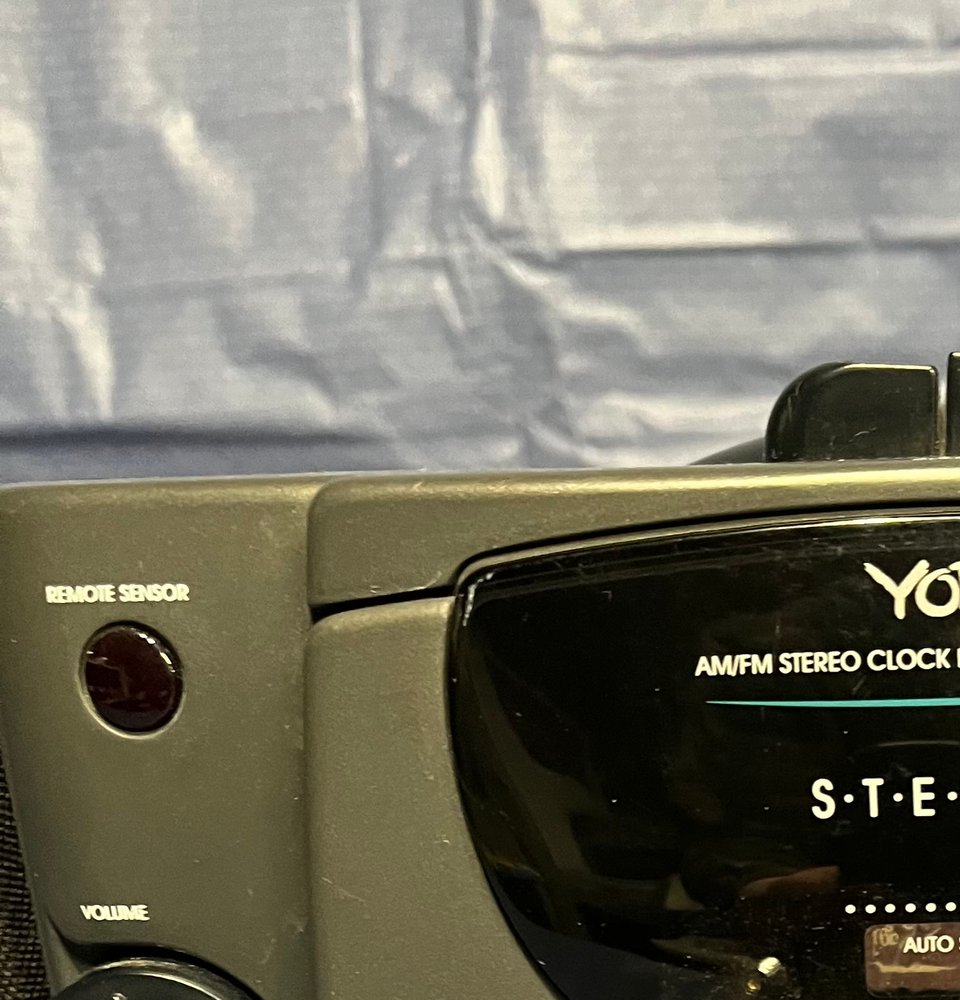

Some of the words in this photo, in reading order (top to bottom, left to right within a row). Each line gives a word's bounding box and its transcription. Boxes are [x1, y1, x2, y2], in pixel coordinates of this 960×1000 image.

[46, 584, 116, 603] REMOTE
[119, 584, 189, 602] SENSOR
[695, 654, 773, 676] AM/FM
[779, 651, 861, 674] STEREO
[867, 648, 951, 671] CLOCK
[80, 905, 150, 920] VOLUME
[903, 935, 954, 953] AUTO
